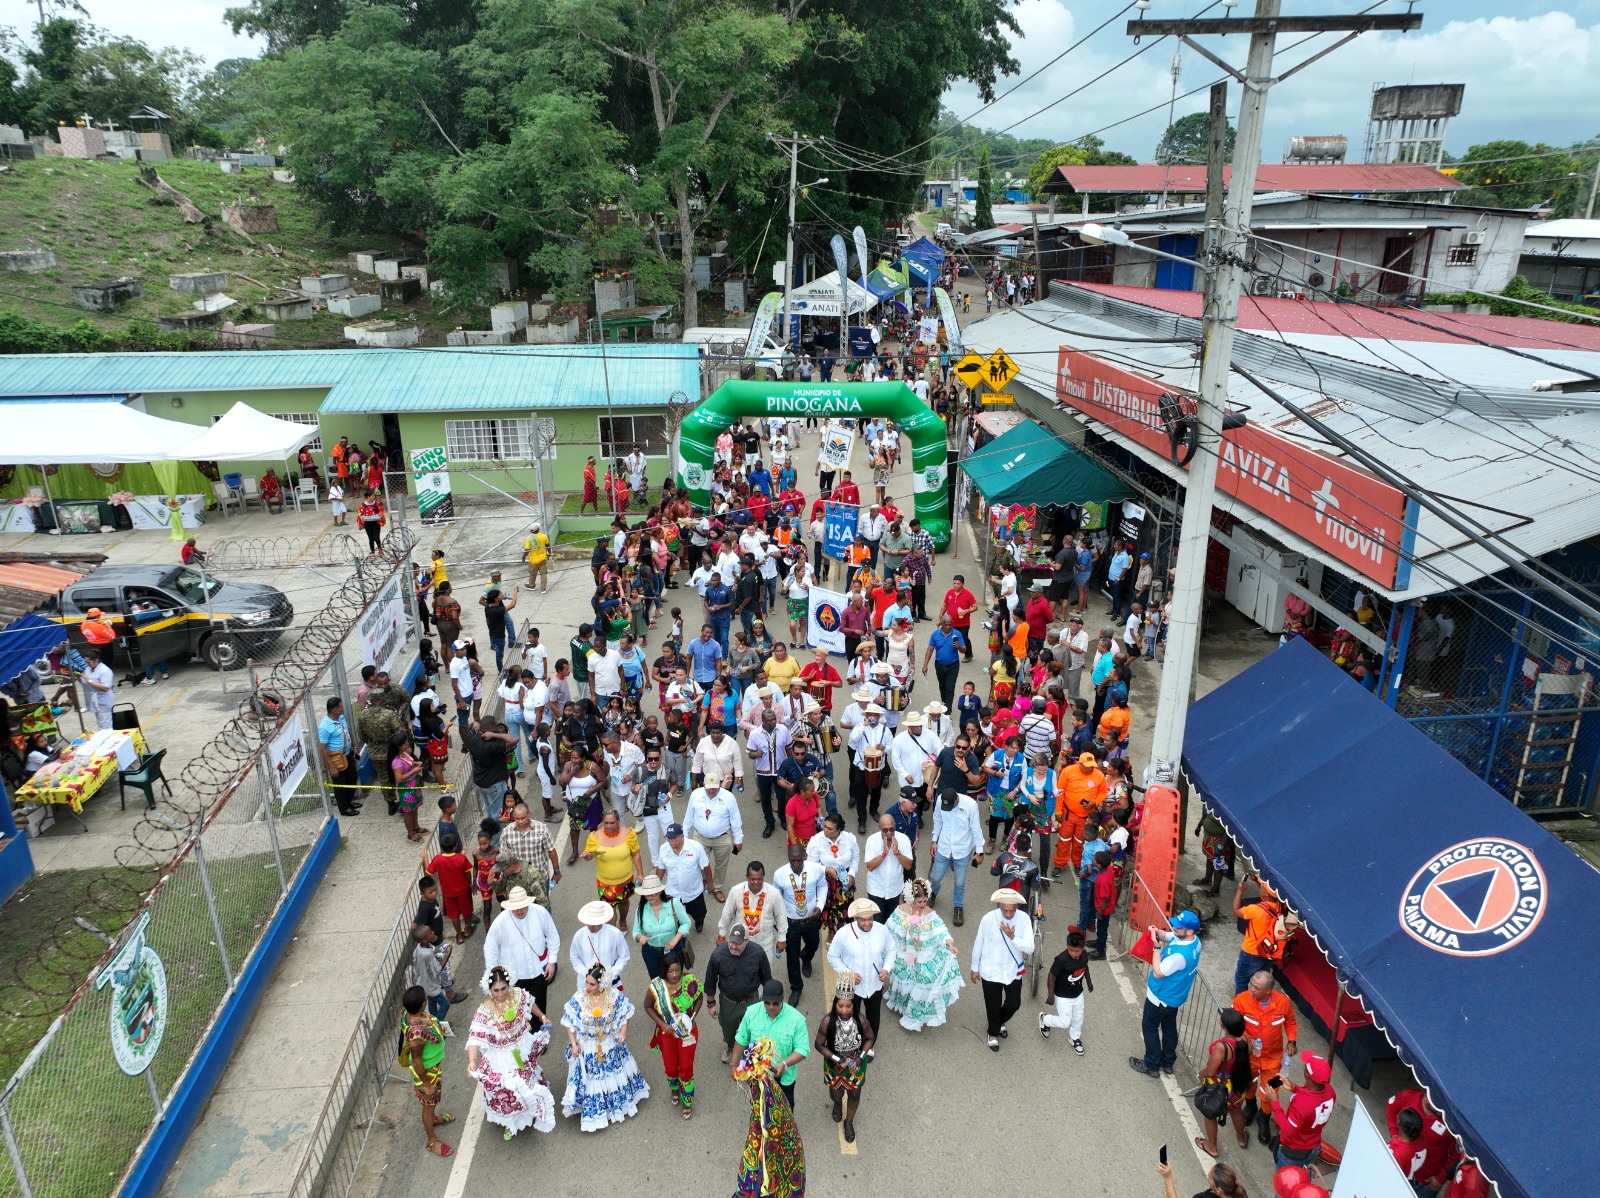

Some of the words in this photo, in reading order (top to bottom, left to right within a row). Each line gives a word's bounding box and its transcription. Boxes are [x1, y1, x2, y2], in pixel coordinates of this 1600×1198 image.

[811, 304, 838, 313] ANATI
[793, 389, 831, 397] MUNICIPIO
[832, 389, 842, 397] DE
[766, 396, 863, 412] PINOGANA
[413, 447, 443, 469] PINO
[828, 523, 854, 543] ISA
[1428, 843, 1539, 891] PROTECCION
[1493, 896, 1538, 940] CIVIL
[1407, 894, 1461, 949] PANAMA
